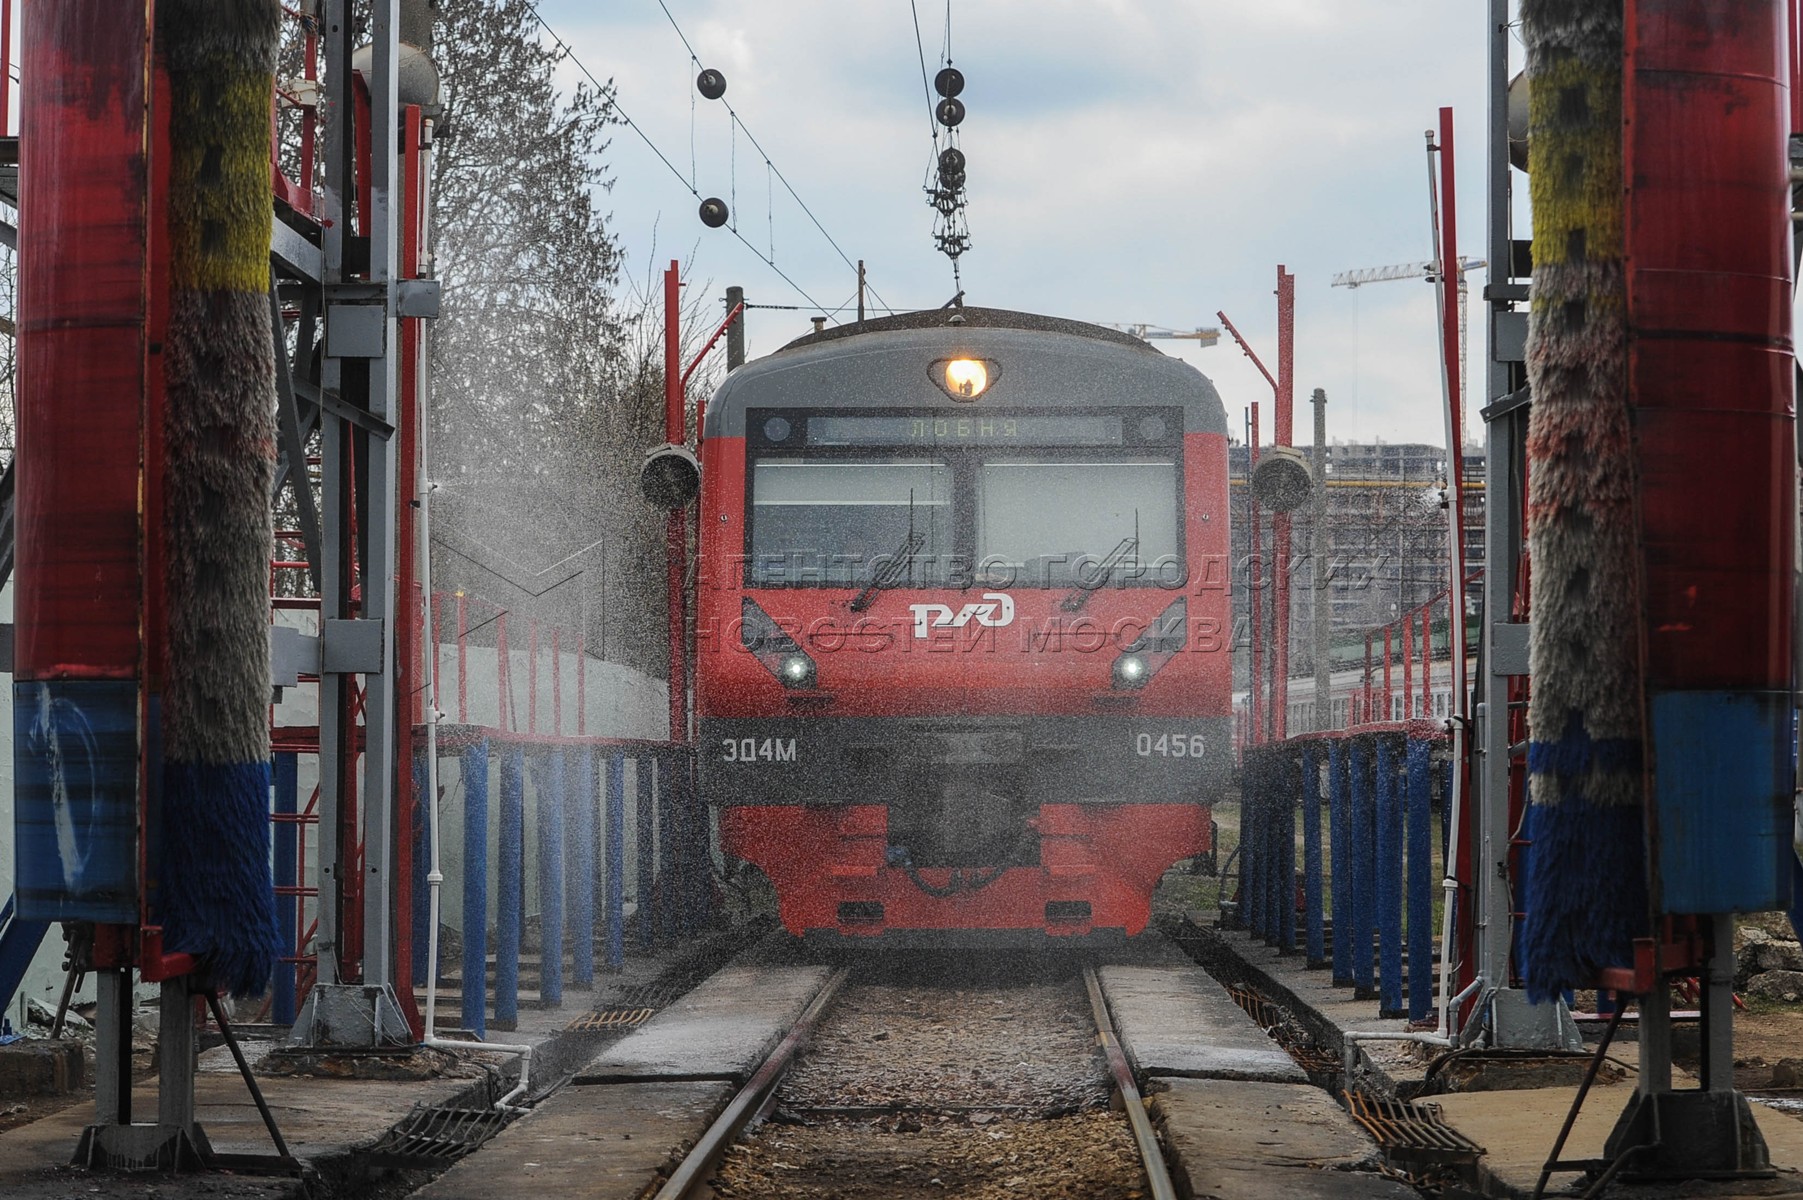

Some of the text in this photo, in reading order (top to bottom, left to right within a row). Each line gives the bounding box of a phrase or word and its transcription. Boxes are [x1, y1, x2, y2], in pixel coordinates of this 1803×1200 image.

[911, 419, 1018, 437] ЛОБНЯ
[722, 738, 797, 761] ЭД4М
[1136, 733, 1205, 757] 0456
